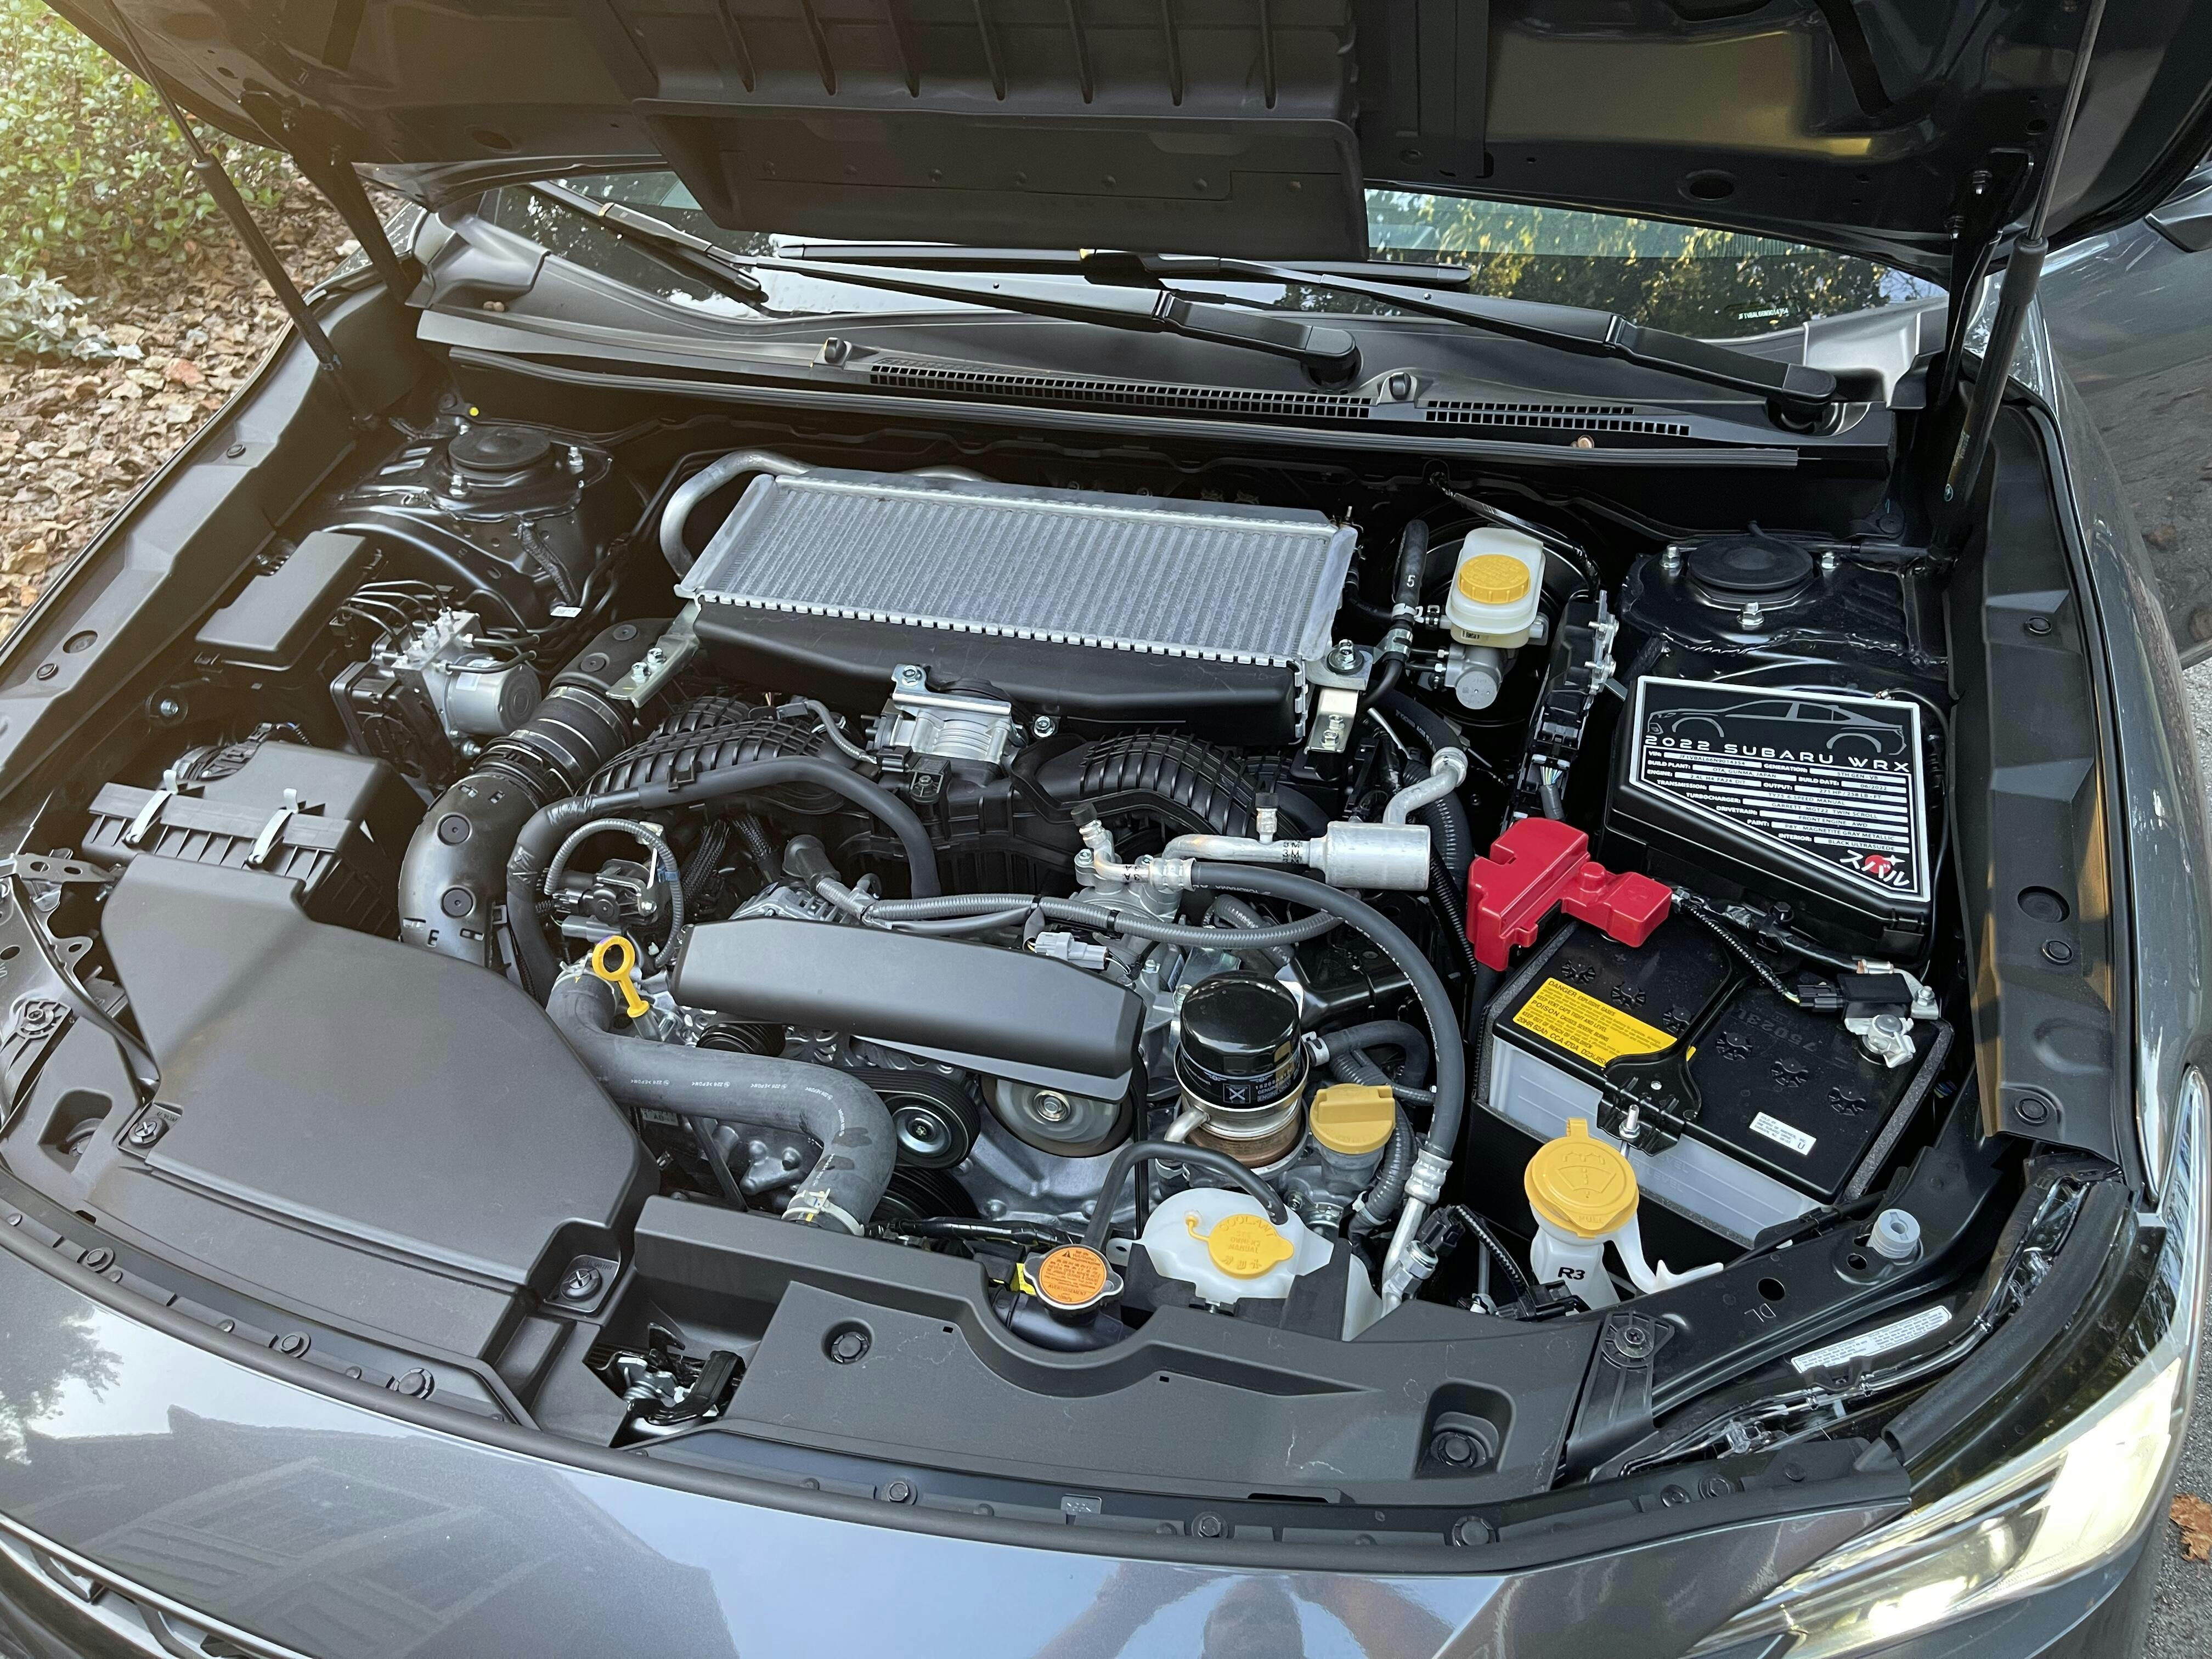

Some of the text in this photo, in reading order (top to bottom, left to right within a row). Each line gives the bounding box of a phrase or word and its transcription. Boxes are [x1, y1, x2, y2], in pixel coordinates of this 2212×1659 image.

[1406, 575, 1415, 588] 5
[1645, 735, 1910, 772] 2022 SUBARU WRX
[1763, 763, 1808, 773] GENERATION:
[1657, 780, 1707, 791] TRANSMISSION:
[1763, 782, 1793, 791] OUTPUT:
[1686, 792, 1741, 804] TURBOCHARGER:
[1716, 805, 1758, 816] DRIVETRAIN:
[1803, 826, 1841, 834] MAGNETITE
[1862, 833, 1895, 841] METALLIC
[1778, 832, 1812, 842] INTERIOR:
[1851, 841, 1895, 851] ULTRASUEDE
[1283, 849, 1300, 858] 3M
[1839, 850, 1910, 886] スバル
[1125, 873, 1140, 882] 3A
[1548, 980, 1577, 997] DANGER
[1531, 1000, 1560, 1017] POISON
[1559, 1005, 1571, 1014] CAPS
[1594, 1023, 1607, 1032] LEVEL
[1516, 1016, 1534, 1028] 20HR
[1533, 1024, 1548, 1035] 62Ah
[1550, 1033, 1564, 1043] CCA
[1564, 1040, 1579, 1051] 470A
[1220, 1216, 1277, 1237] COOLANT
[1578, 1216, 1603, 1224] PULL
[1228, 1244, 1259, 1254] MANUAL
[1558, 1267, 1585, 1280] R3
